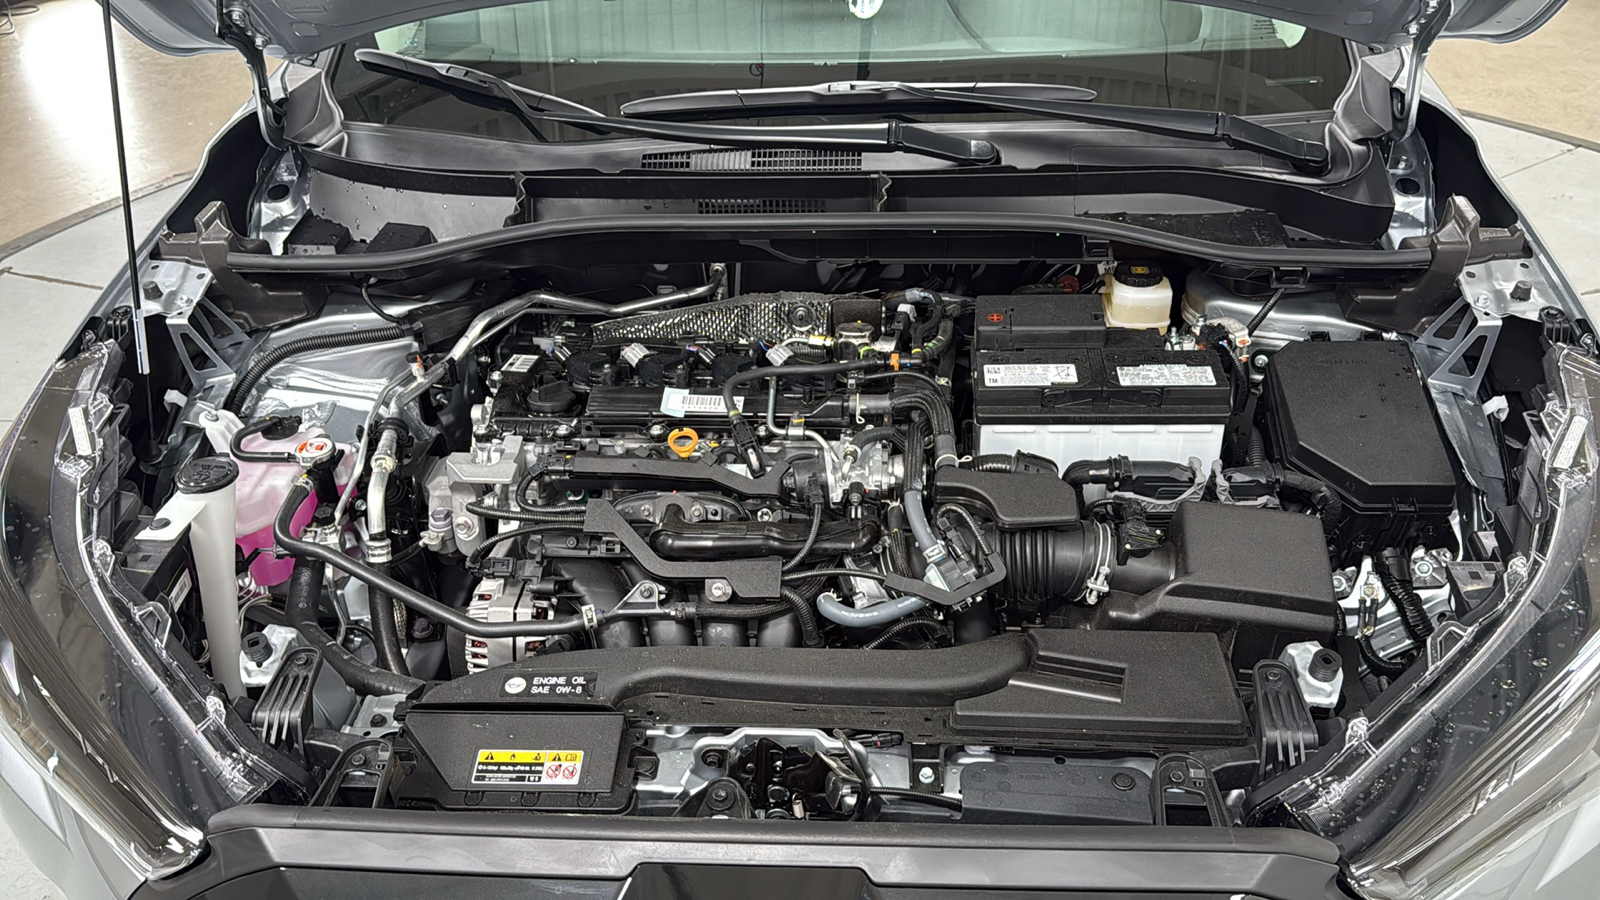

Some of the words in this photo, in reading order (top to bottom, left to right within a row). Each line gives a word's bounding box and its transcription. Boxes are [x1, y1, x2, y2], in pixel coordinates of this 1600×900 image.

[1344, 480, 1356, 492] A3
[532, 676, 567, 685] ENGINE
[571, 676, 587, 685] OIL
[530, 685, 550, 694] SAE
[555, 685, 583, 694] 0W-8
